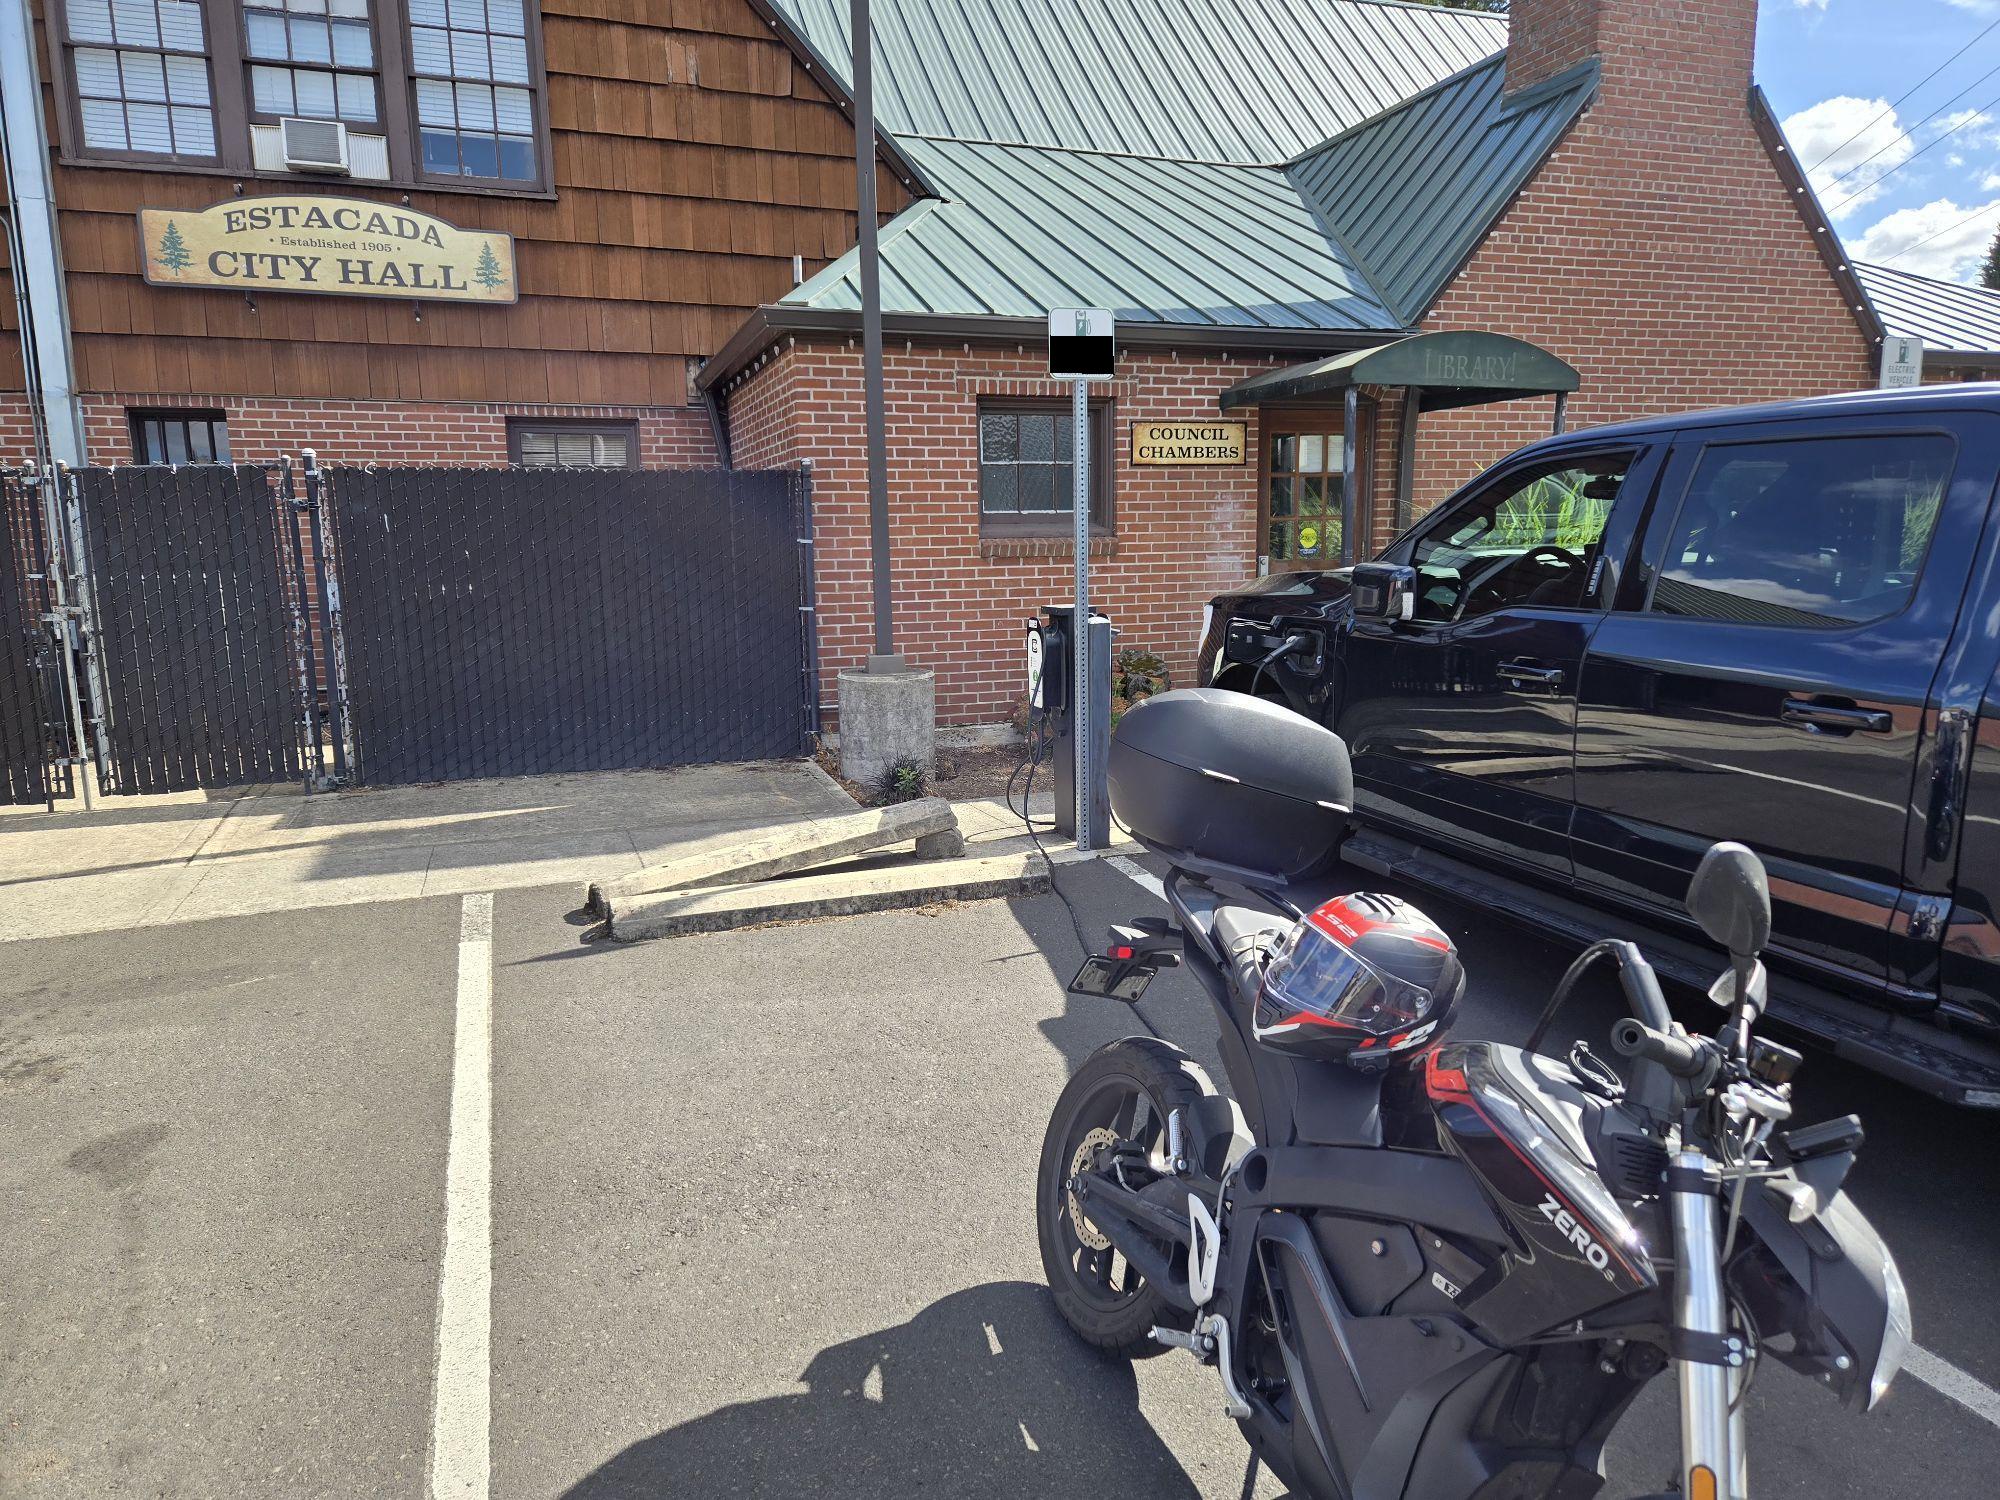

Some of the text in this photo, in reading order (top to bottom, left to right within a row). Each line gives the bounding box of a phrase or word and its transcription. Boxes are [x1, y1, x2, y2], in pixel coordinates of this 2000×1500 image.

[223, 206, 445, 249] ESTACADA
[279, 236, 393, 253] Established 1905
[207, 250, 468, 292] CITY HALL
[1888, 365, 1916, 374] ELECTRIC
[1149, 427, 1229, 441] COUNCIL
[1138, 446, 1240, 459] CHAMBERS
[1538, 1192, 1609, 1270] ZERO
